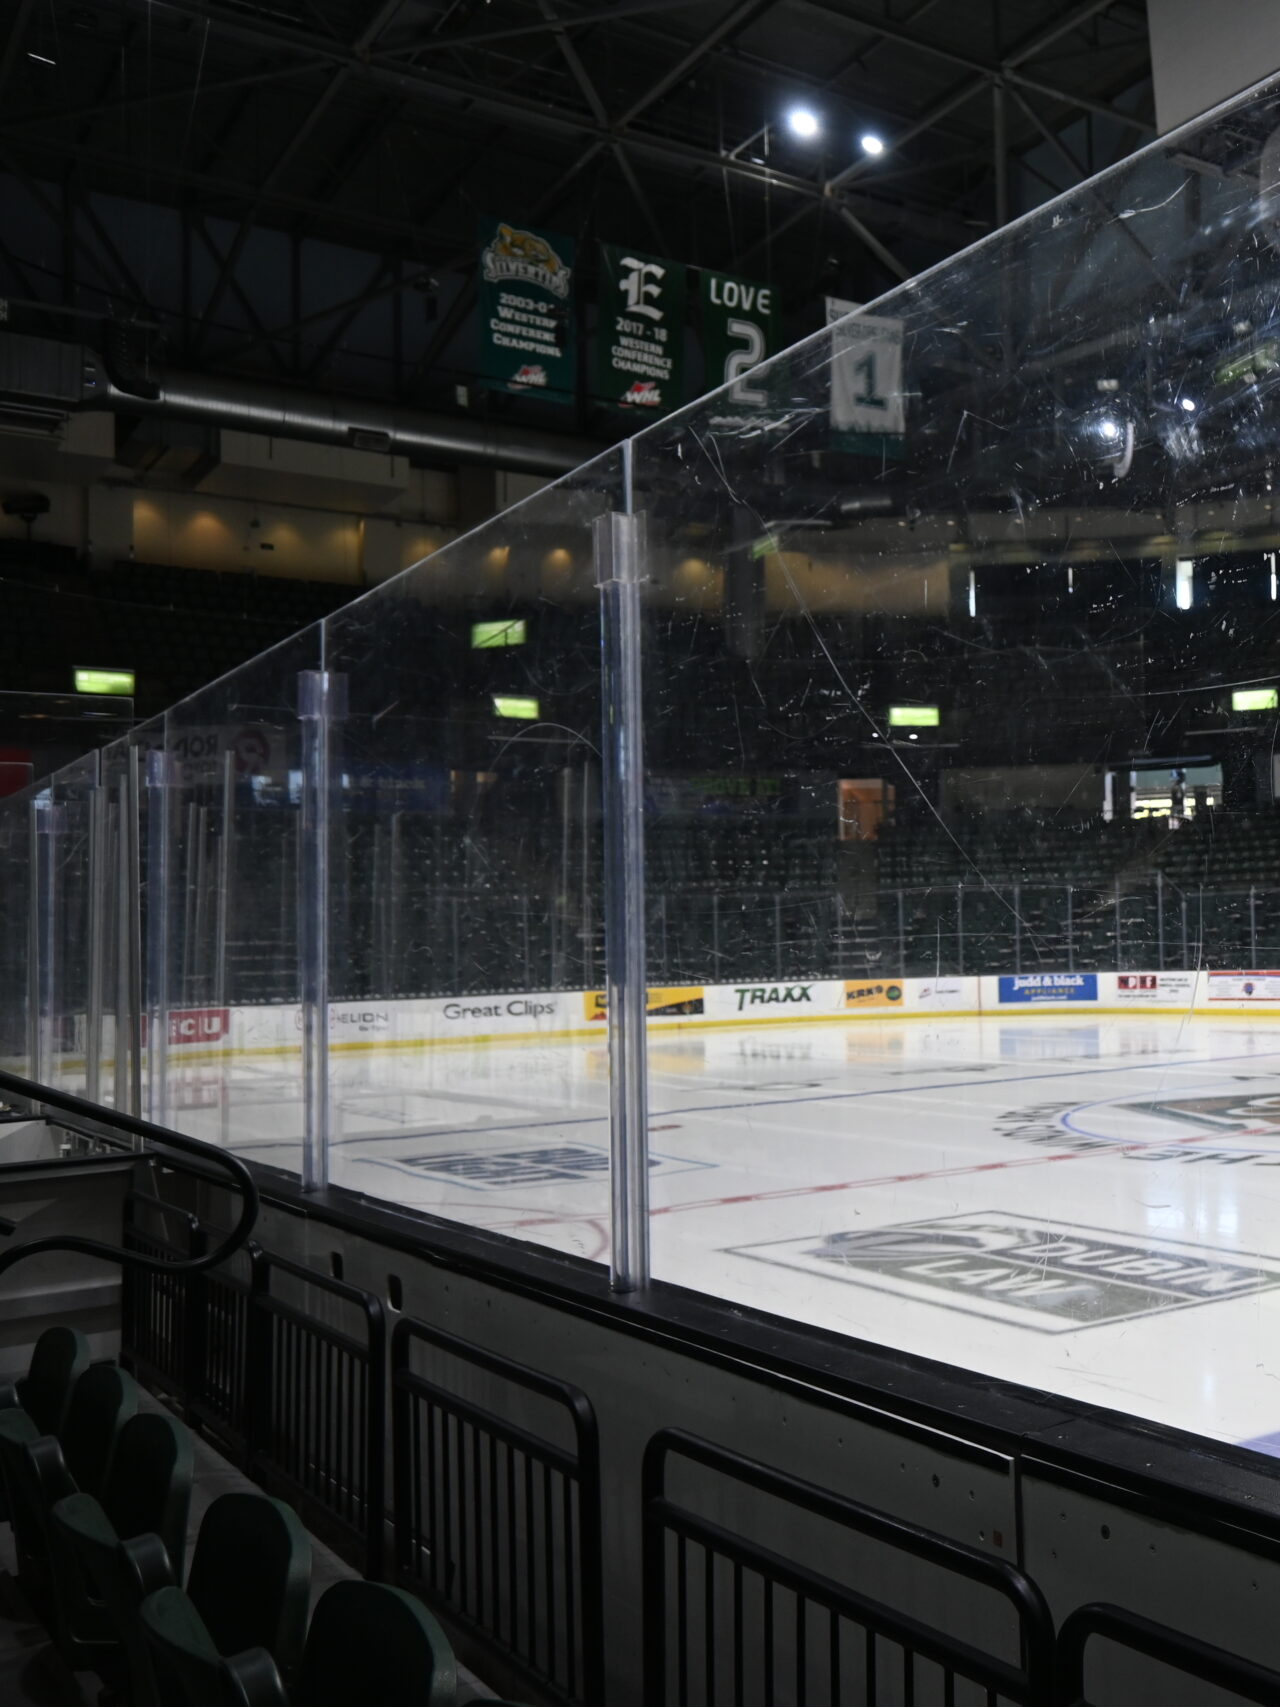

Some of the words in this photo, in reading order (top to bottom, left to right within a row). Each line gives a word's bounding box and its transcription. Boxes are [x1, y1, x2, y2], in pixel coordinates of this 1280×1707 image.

[618, 257, 667, 321] E
[709, 277, 771, 314] LOVE
[497, 306, 558, 329] WESTERN
[616, 317, 643, 336] 2017
[654, 326, 668, 342] 18
[493, 333, 562, 358] CHAMPIONS
[611, 345, 673, 369] CONFERENCE
[619, 336, 664, 356] WESTERN
[612, 357, 671, 380] CHAMPIONS
[723, 317, 766, 407] 2
[848, 348, 886, 410] 1
[443, 1003, 501, 1020] Great
[506, 1000, 556, 1018] Clips
[734, 984, 815, 1012] TRAXX
[897, 1258, 1082, 1299] LAW
[1002, 1240, 1272, 1293] DUBIN
